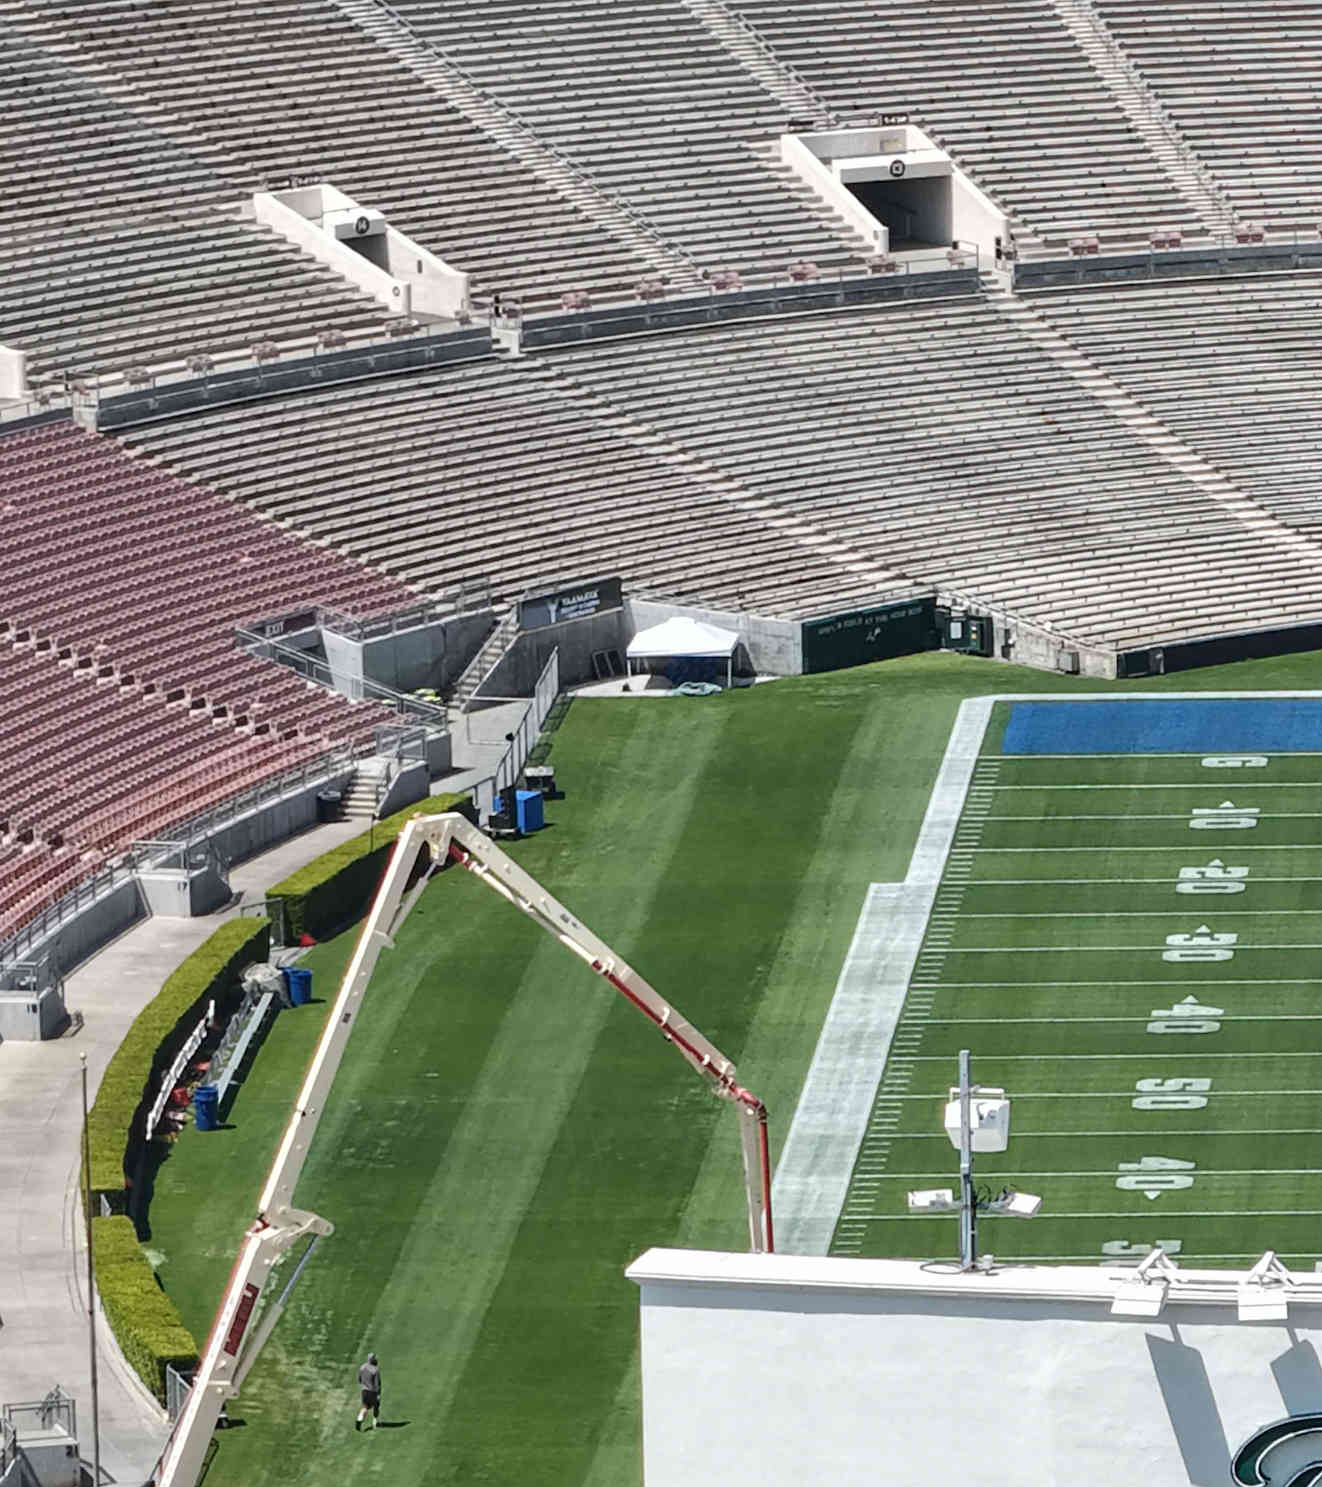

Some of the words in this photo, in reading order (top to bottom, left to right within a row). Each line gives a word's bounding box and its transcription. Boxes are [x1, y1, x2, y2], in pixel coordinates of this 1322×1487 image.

[1175, 866, 1250, 894] 20
[1162, 933, 1239, 962] 30
[1131, 1077, 1213, 1110] 50
